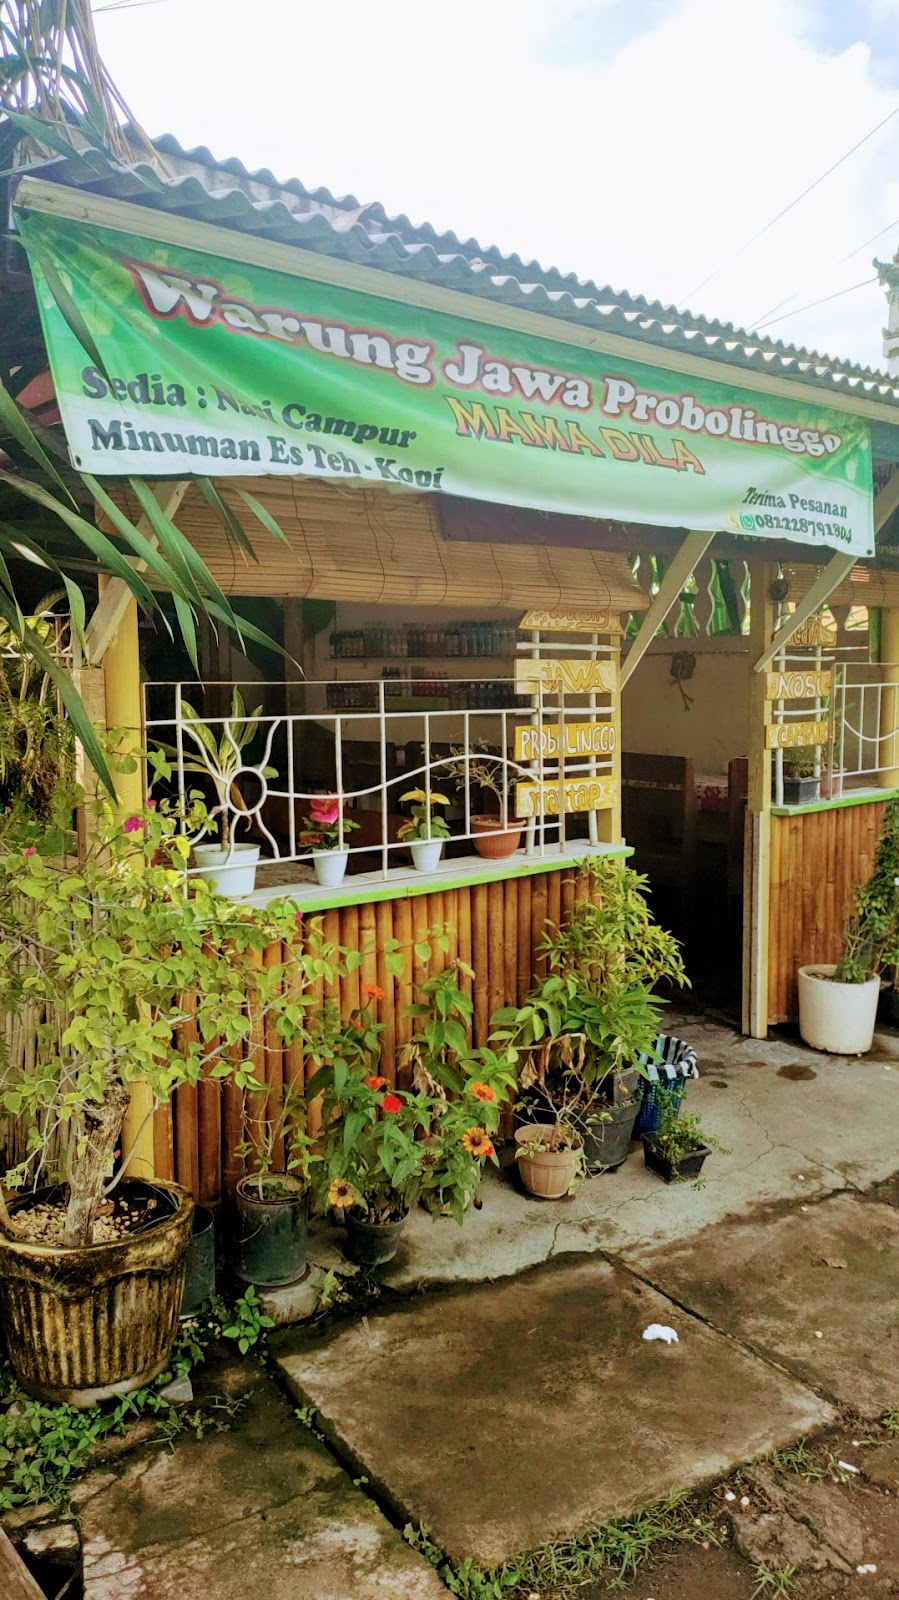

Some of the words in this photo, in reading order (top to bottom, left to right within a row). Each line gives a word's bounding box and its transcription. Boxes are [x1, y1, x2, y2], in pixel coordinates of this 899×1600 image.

[129, 262, 434, 386] Warung
[442, 344, 593, 411] Jawa
[600, 375, 843, 459] Probolinggo
[82, 366, 187, 407] Sedia
[210, 384, 278, 424] Nasi
[281, 403, 417, 448] Campur
[443, 395, 606, 459] MAMA
[599, 425, 706, 475] DILA
[87, 418, 261, 462] Minuman
[266, 435, 304, 465] Es
[307, 443, 361, 474] Teh
[742, 486, 787, 509] Terima
[787, 493, 848, 519] Pesanan
[755, 514, 852, 545] 082228791804
